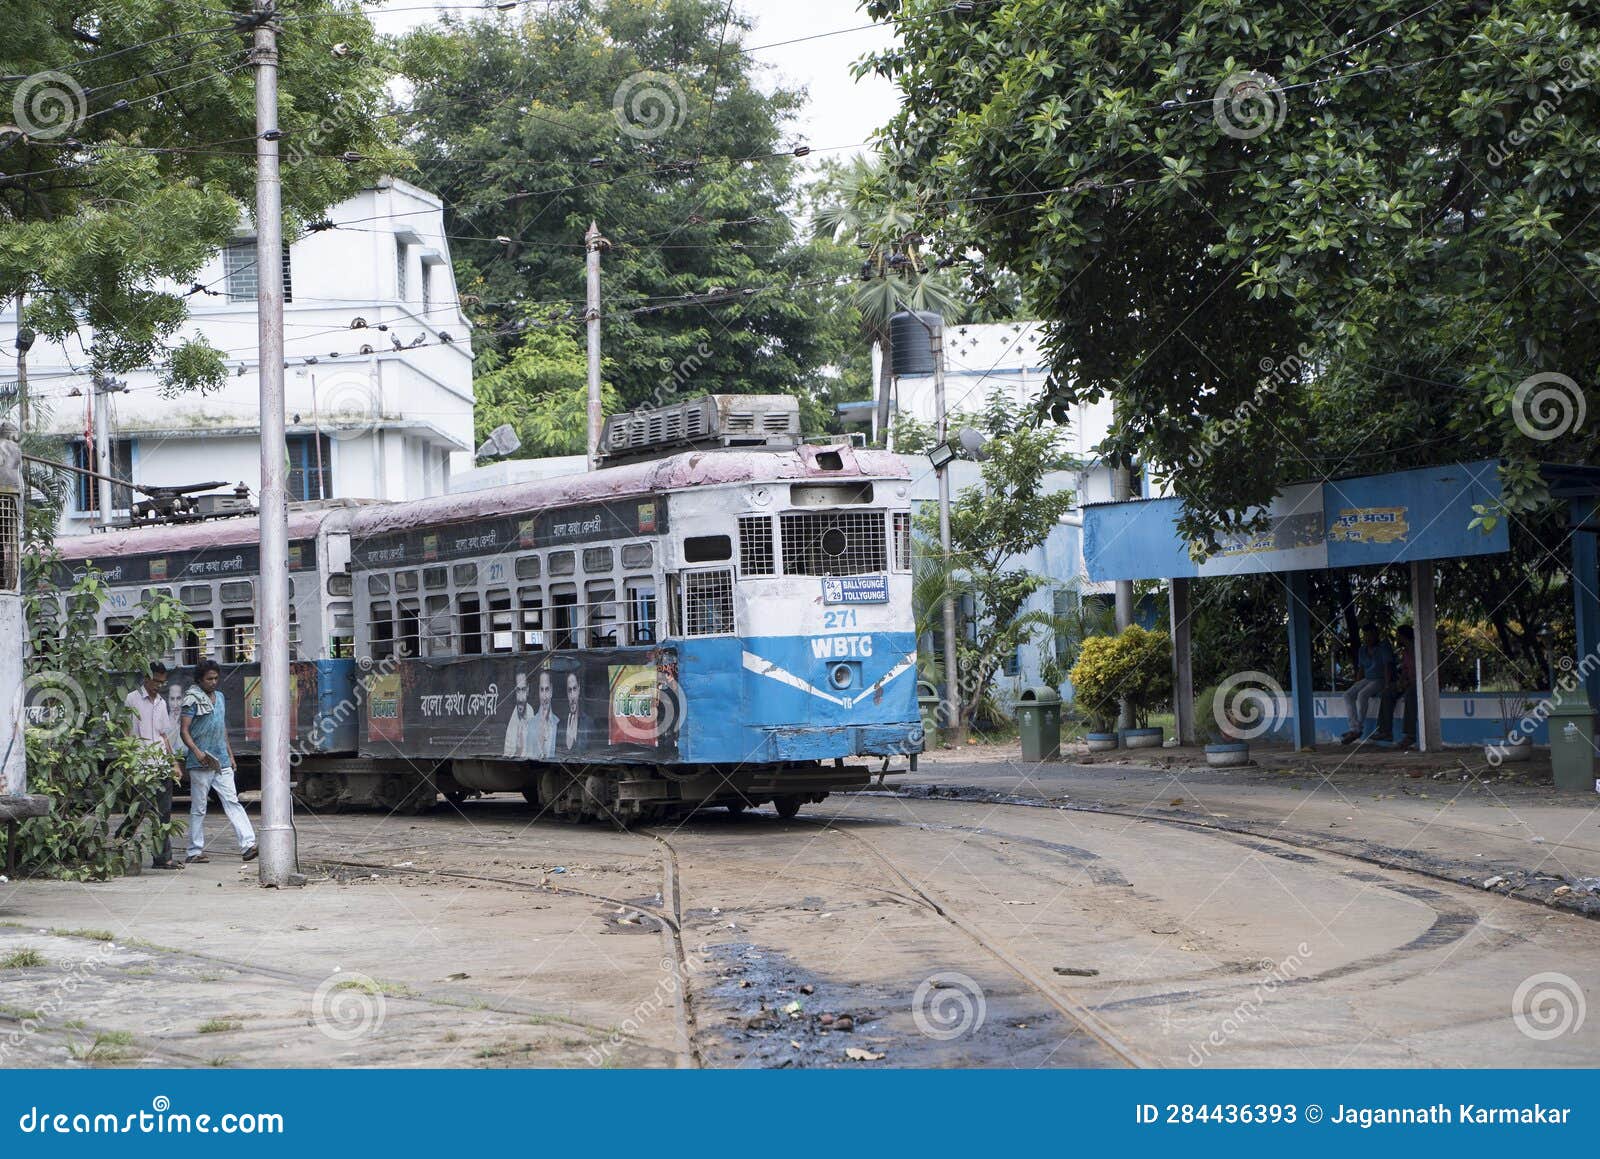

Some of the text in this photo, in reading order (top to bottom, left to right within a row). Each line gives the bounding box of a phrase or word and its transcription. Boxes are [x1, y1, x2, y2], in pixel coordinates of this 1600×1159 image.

[490, 563, 504, 580] 271
[842, 579, 885, 589] BALLYGUNGE
[843, 590, 886, 600] TOLLYGUNGE
[823, 608, 857, 629] 271
[811, 635, 873, 659] WBTC
[420, 682, 499, 717] বলো কথা কেশরী
[1463, 700, 1475, 717] U
